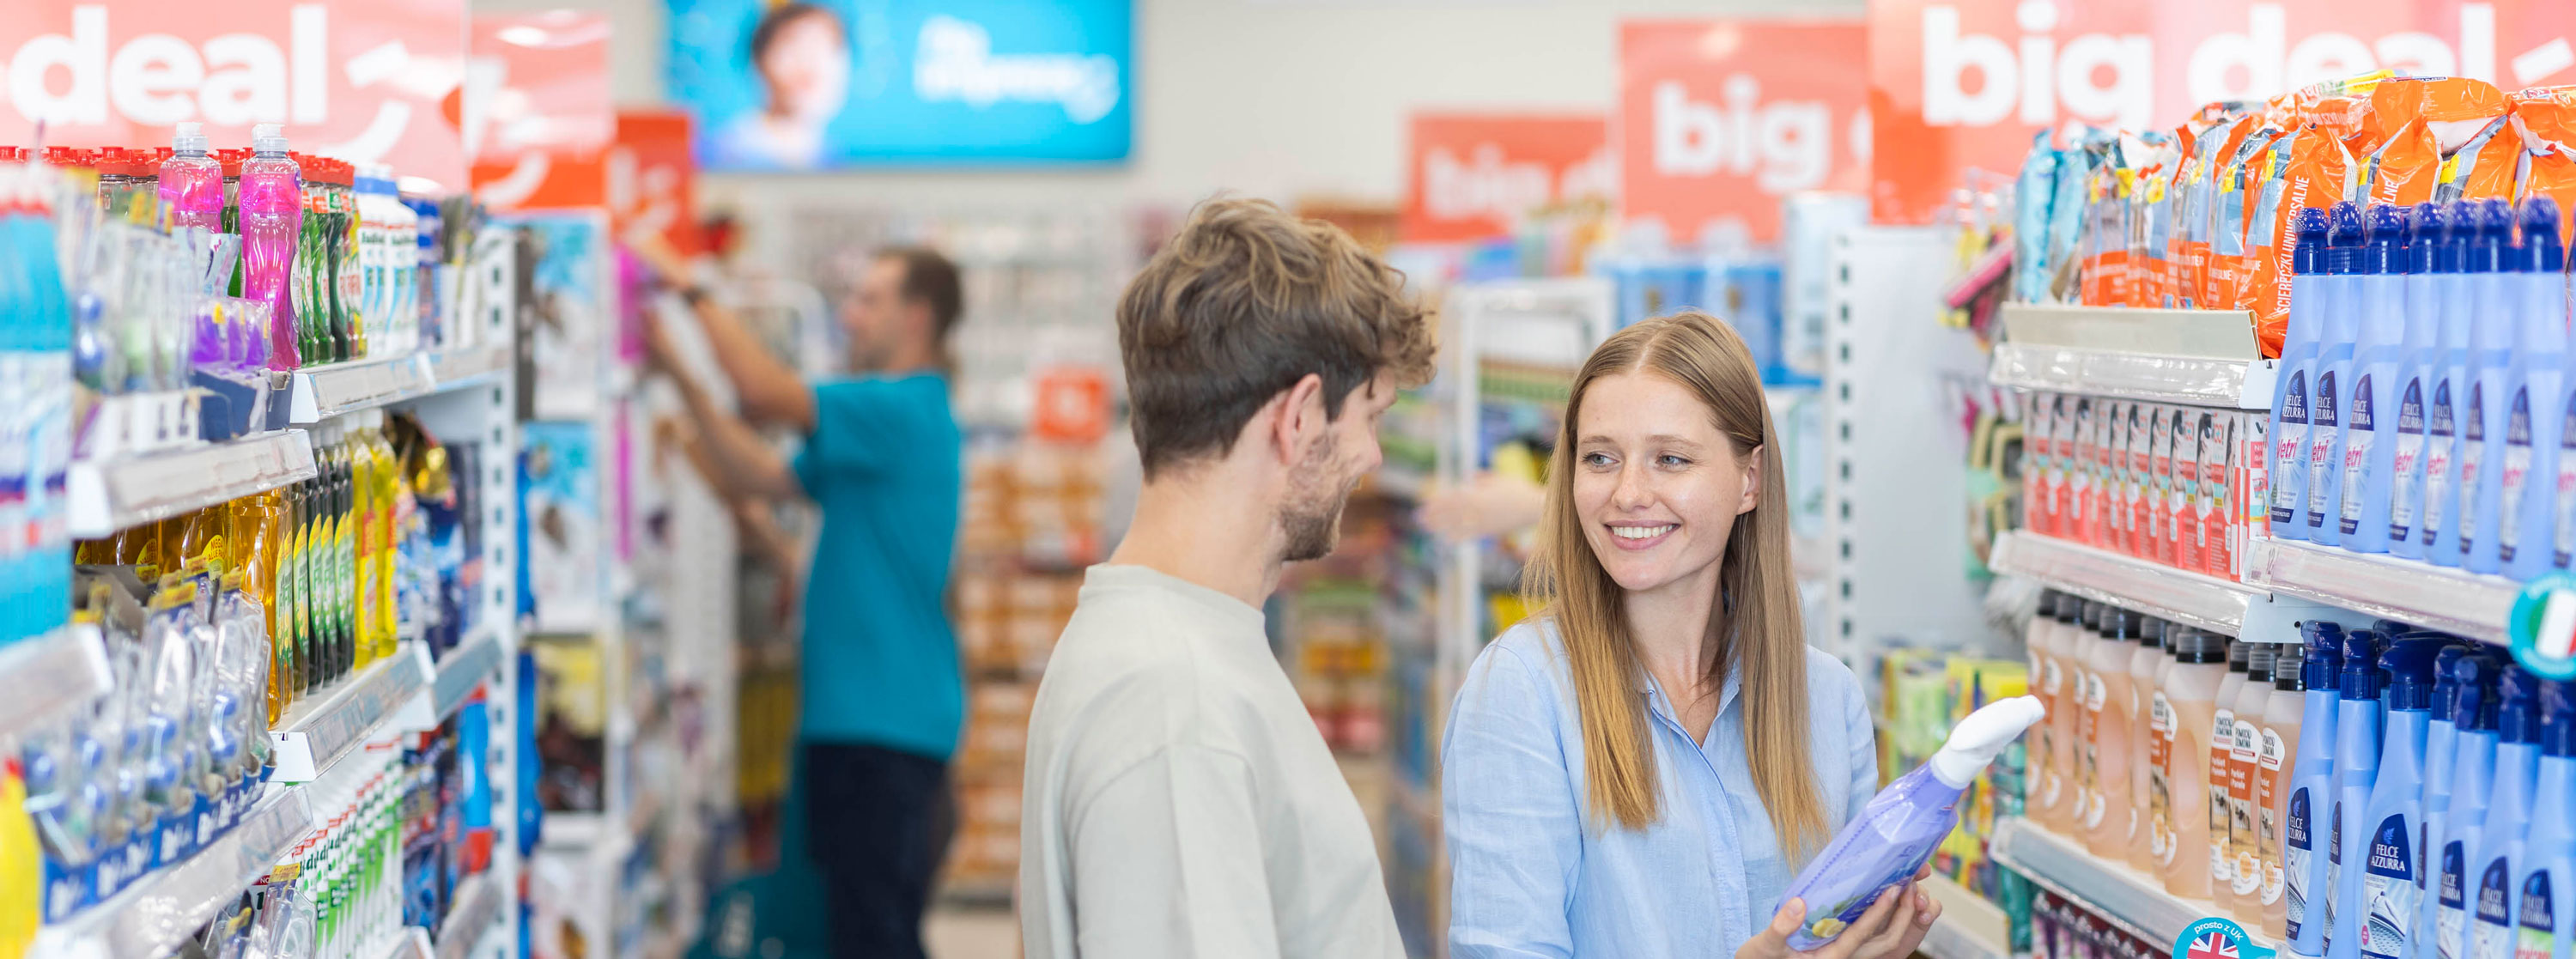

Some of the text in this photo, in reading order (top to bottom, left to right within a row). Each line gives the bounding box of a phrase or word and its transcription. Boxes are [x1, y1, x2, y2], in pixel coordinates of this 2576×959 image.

[9, 4, 328, 125] deal
[1923, 0, 2154, 139] big
[1654, 74, 1827, 192] big
[2276, 436, 2299, 461] Vetri
[2370, 855, 2406, 872] AZZURRA
[2376, 843, 2399, 859] FELCE
[2195, 921, 2223, 934] prosto
[2231, 927, 2244, 942] UK
